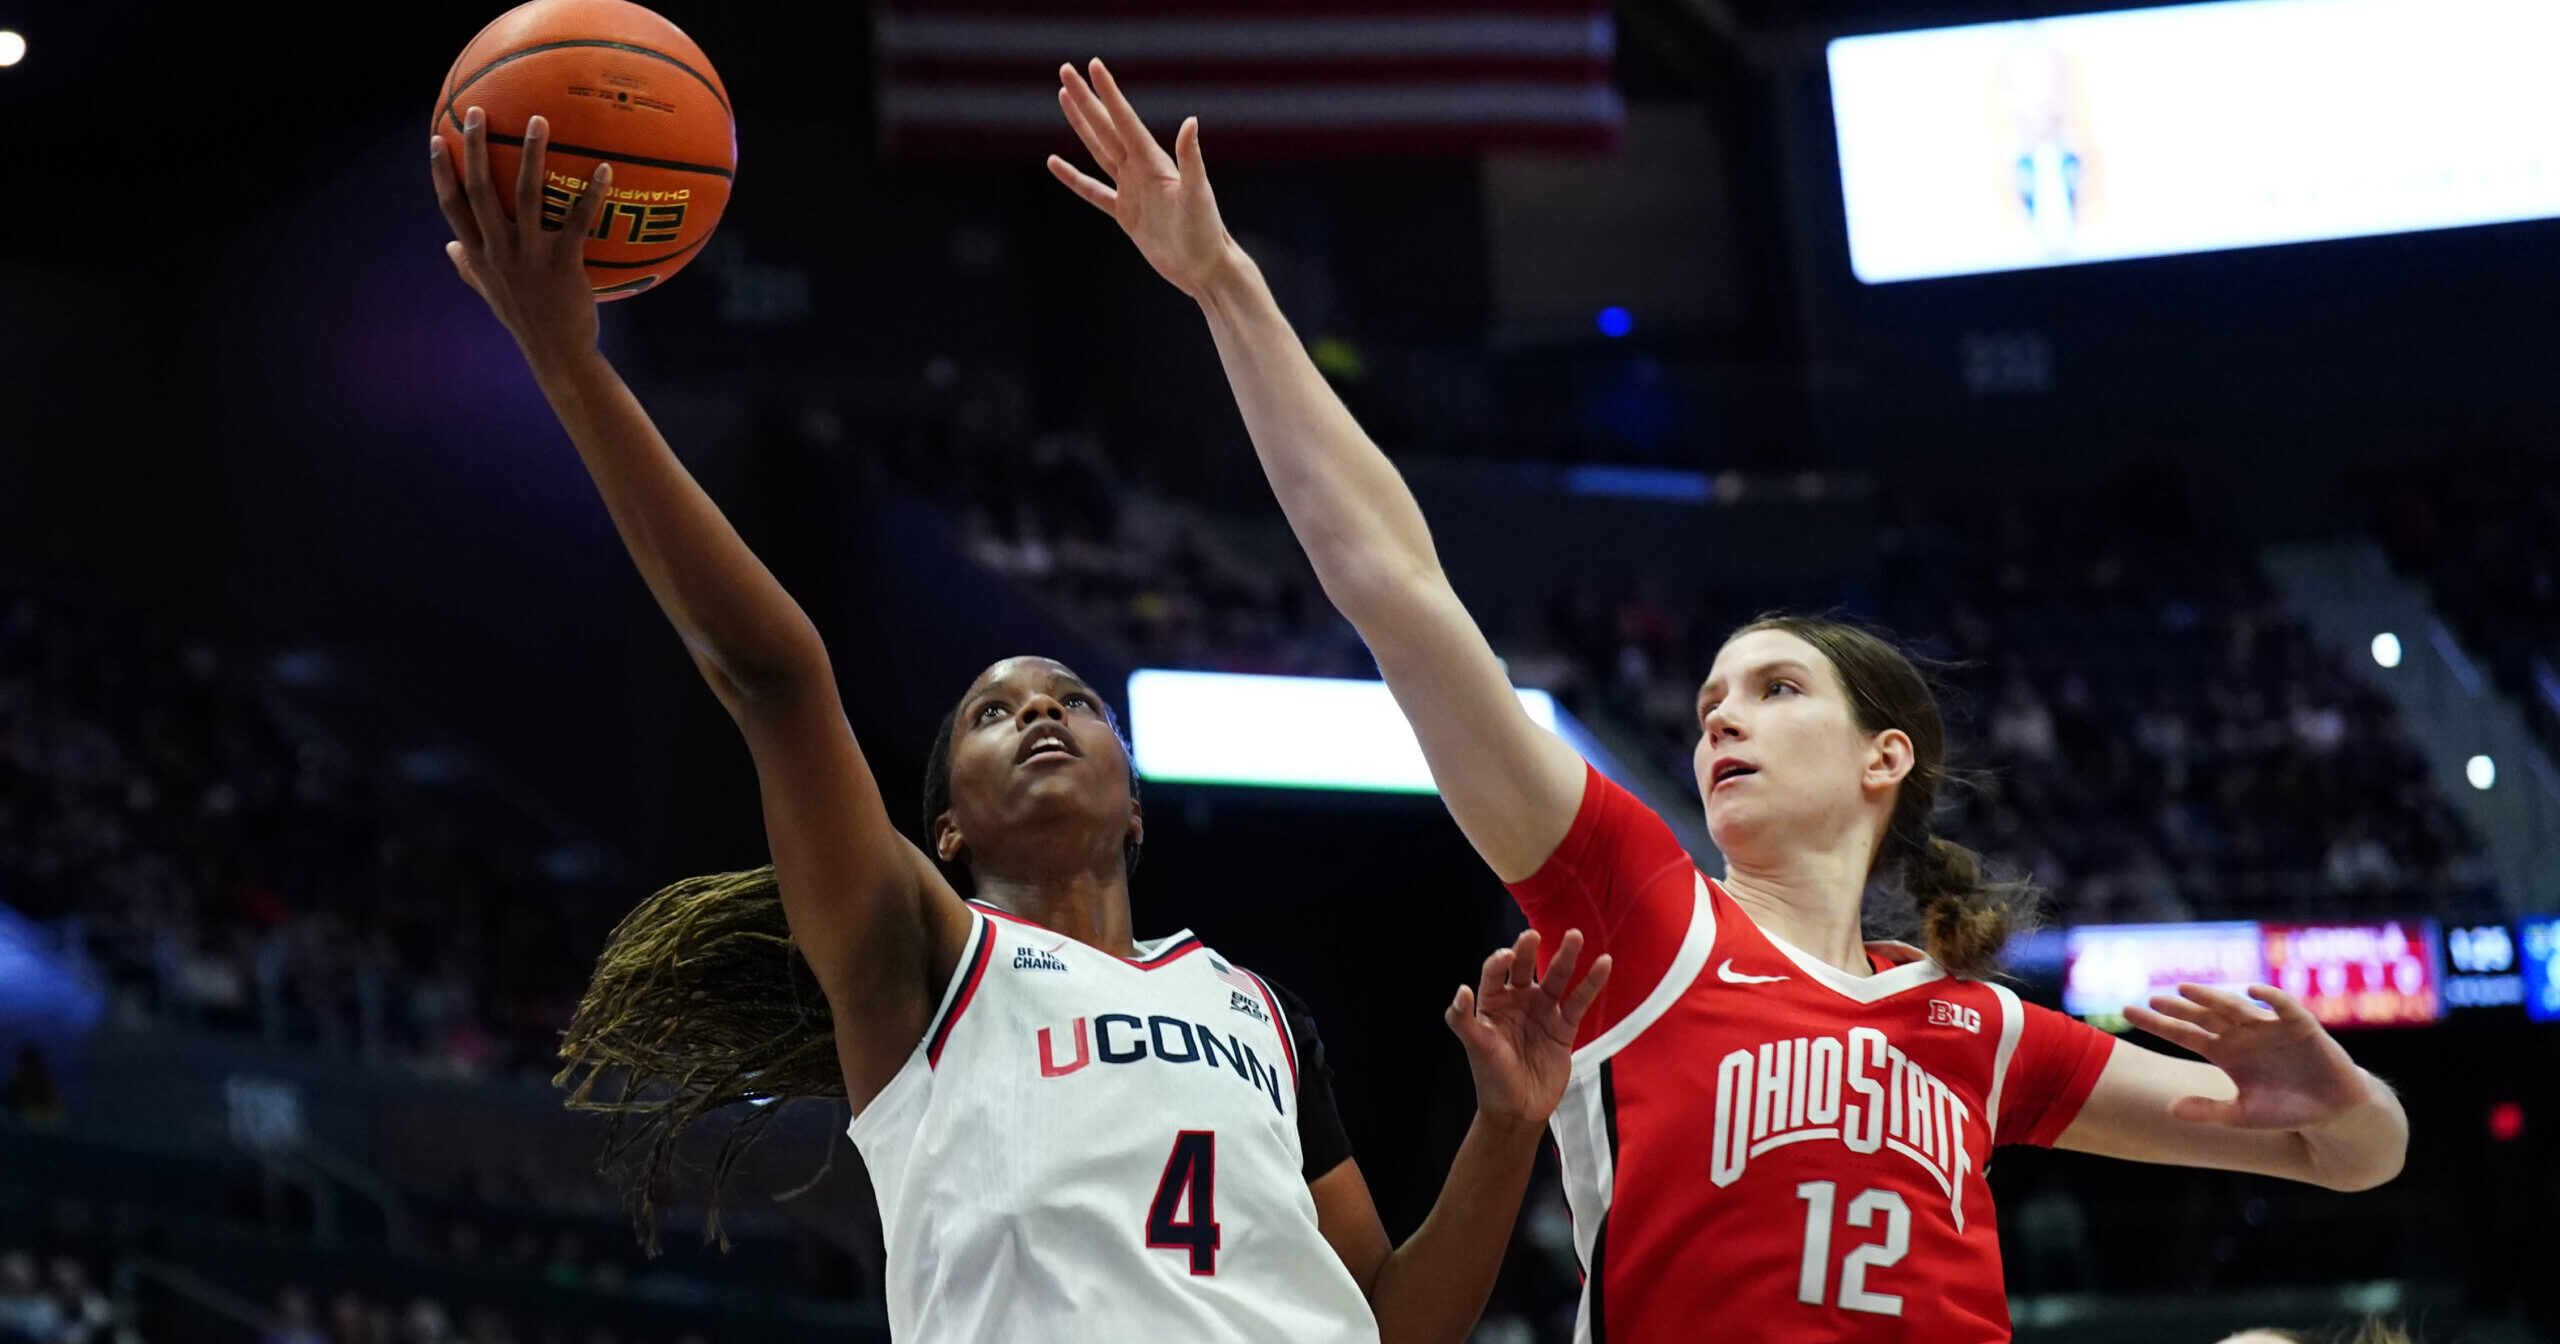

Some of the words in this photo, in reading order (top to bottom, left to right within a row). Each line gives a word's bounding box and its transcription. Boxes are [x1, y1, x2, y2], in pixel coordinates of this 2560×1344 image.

[545, 170, 690, 201] CHAMPISH
[541, 185, 688, 244] ELIE
[1013, 957, 1068, 971] CHANGE
[1017, 947, 1035, 957] BE
[1040, 949, 1062, 962] TH
[1231, 991, 1260, 1009] BIG
[1037, 1014, 1285, 1117] UCONN
[1145, 1130, 1220, 1277] 4
[1796, 1180, 1912, 1317] 12
